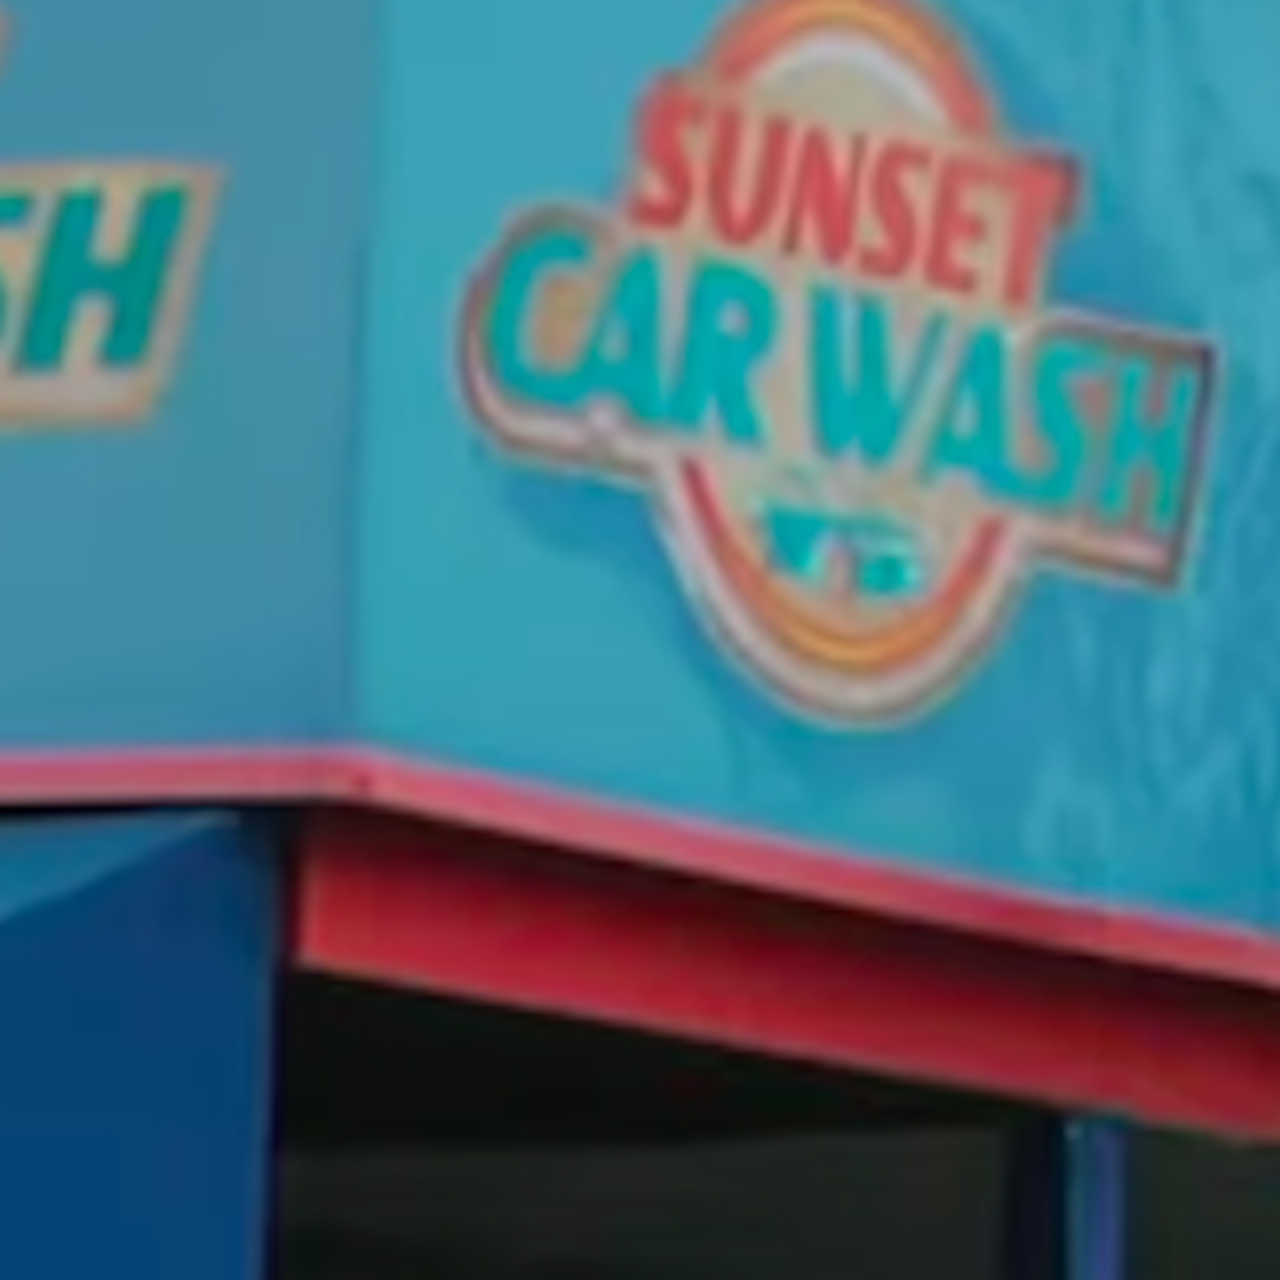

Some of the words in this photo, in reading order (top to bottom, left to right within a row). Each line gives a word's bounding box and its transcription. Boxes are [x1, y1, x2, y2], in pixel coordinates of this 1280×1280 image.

[629, 80, 1072, 308] SUNSET
[487, 228, 779, 444] CAR
[811, 278, 1200, 534] WASH
